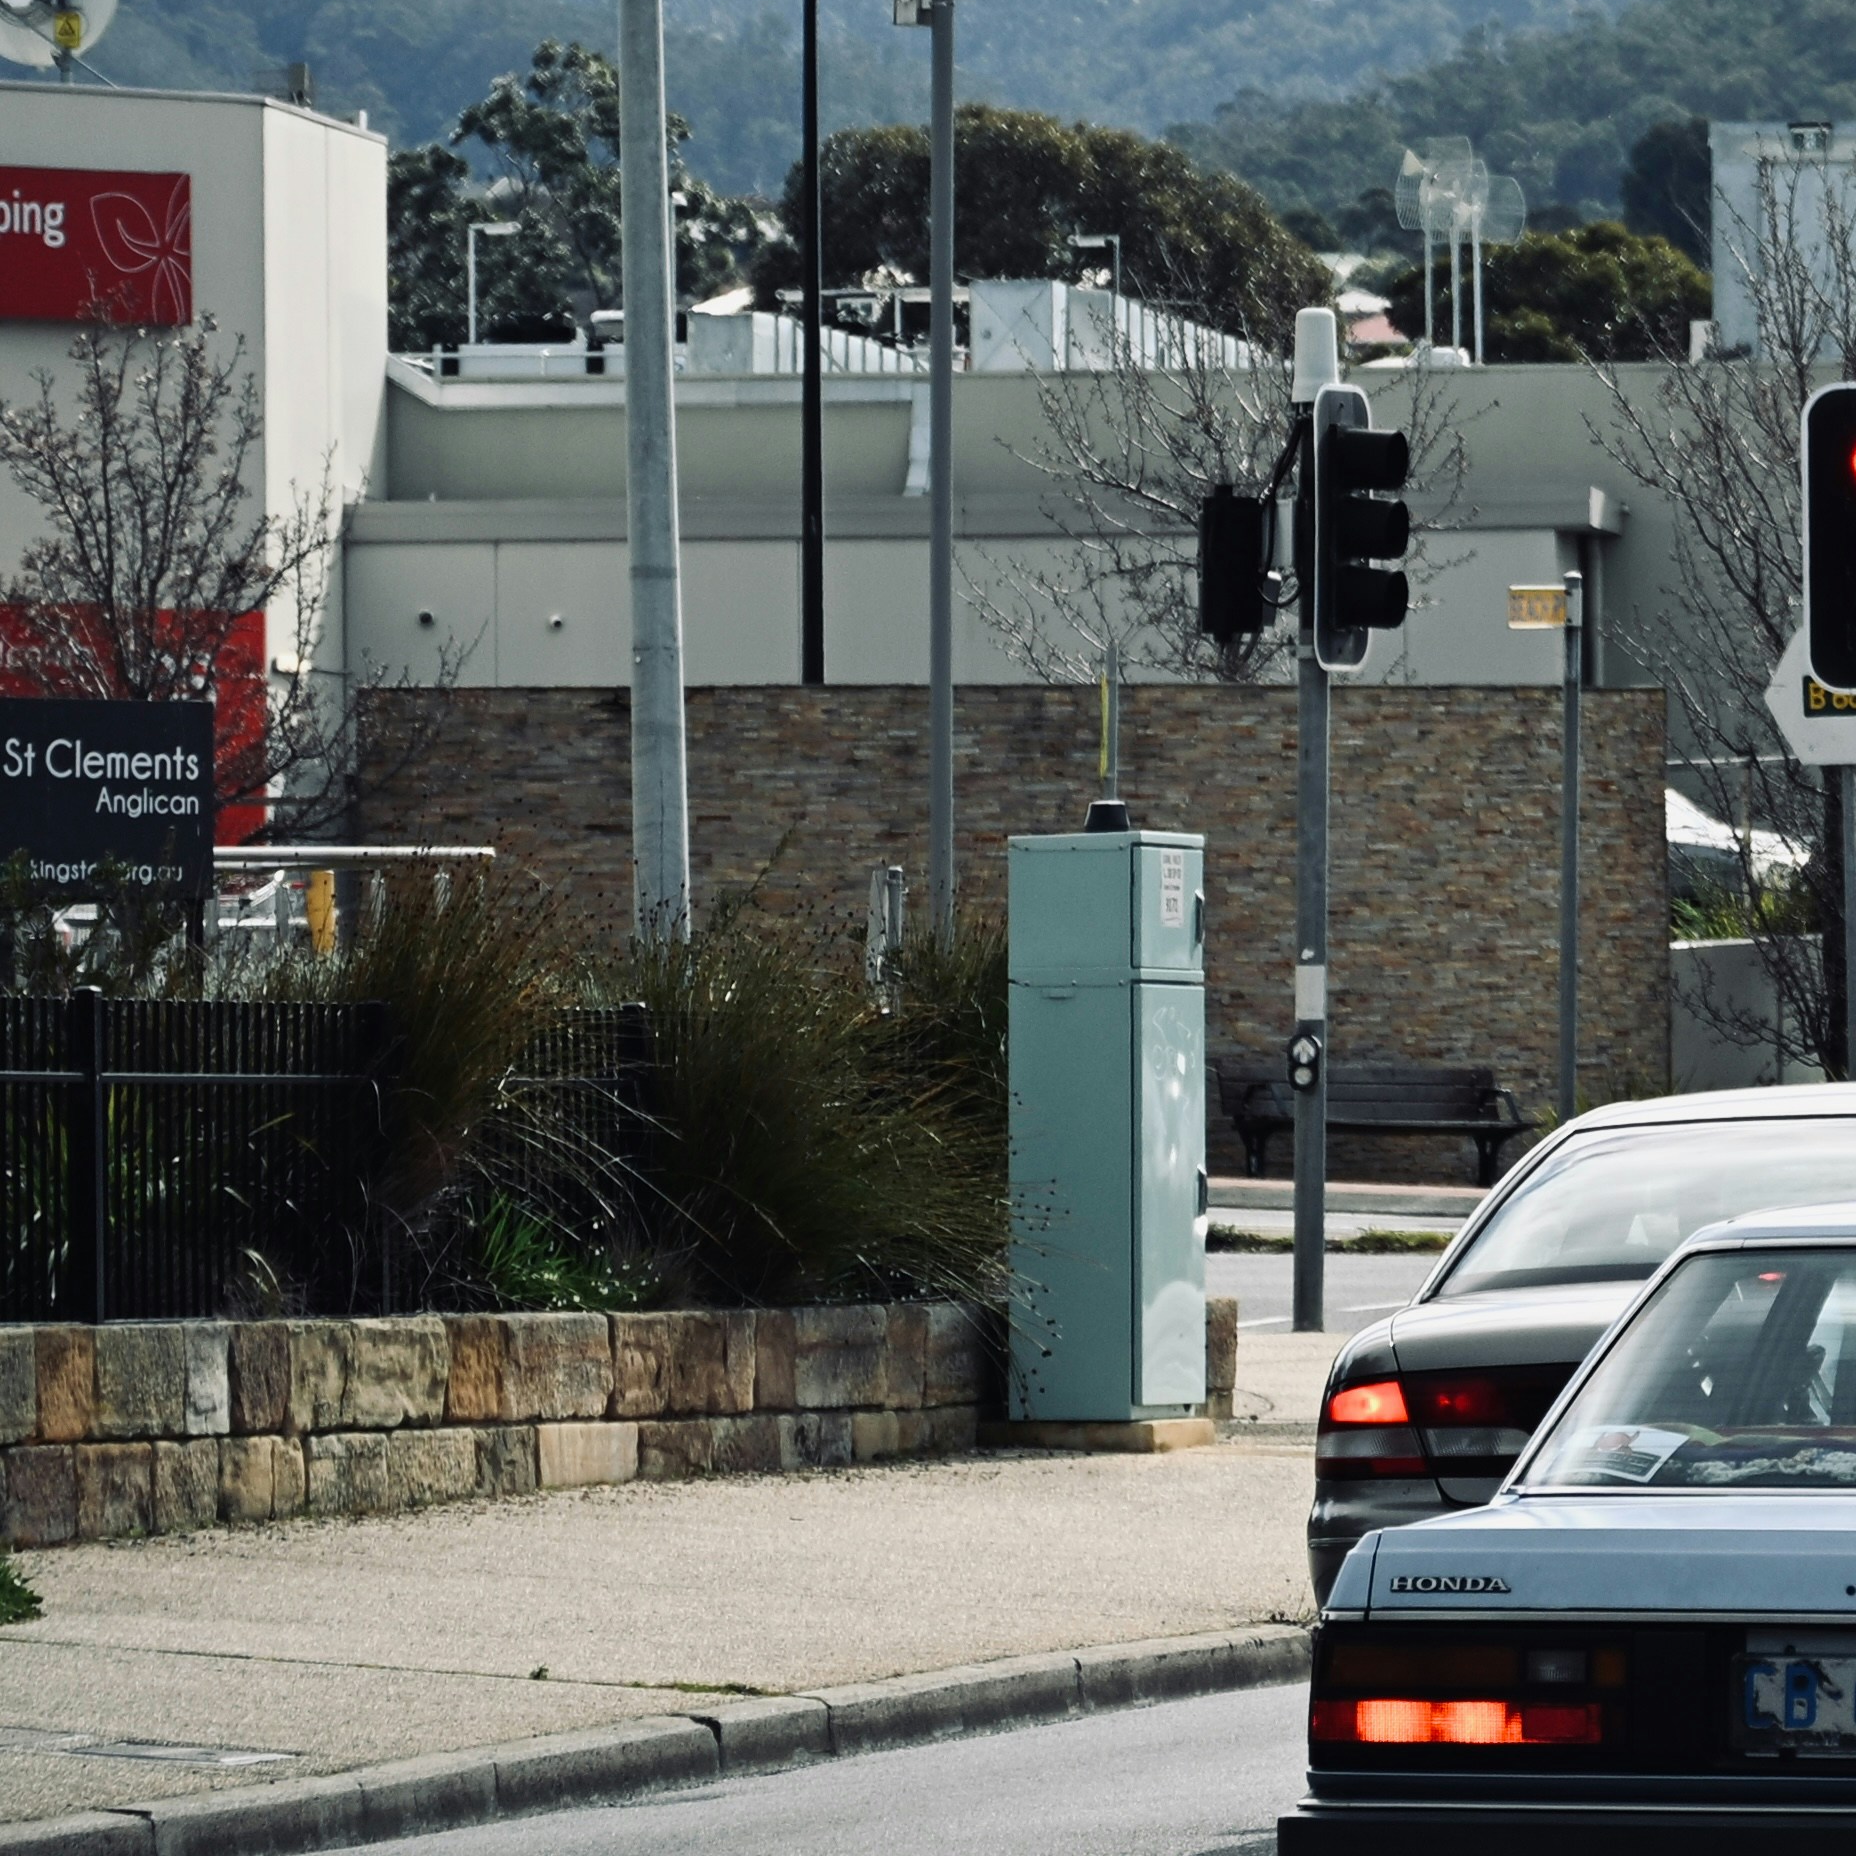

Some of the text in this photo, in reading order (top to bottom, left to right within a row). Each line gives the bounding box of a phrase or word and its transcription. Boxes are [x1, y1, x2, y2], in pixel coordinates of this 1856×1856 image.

[1809, 682, 1826, 710] B
[3, 737, 199, 780] St Clements
[95, 786, 199, 818] Anglican
[1391, 1576, 1511, 1592] HONDA
